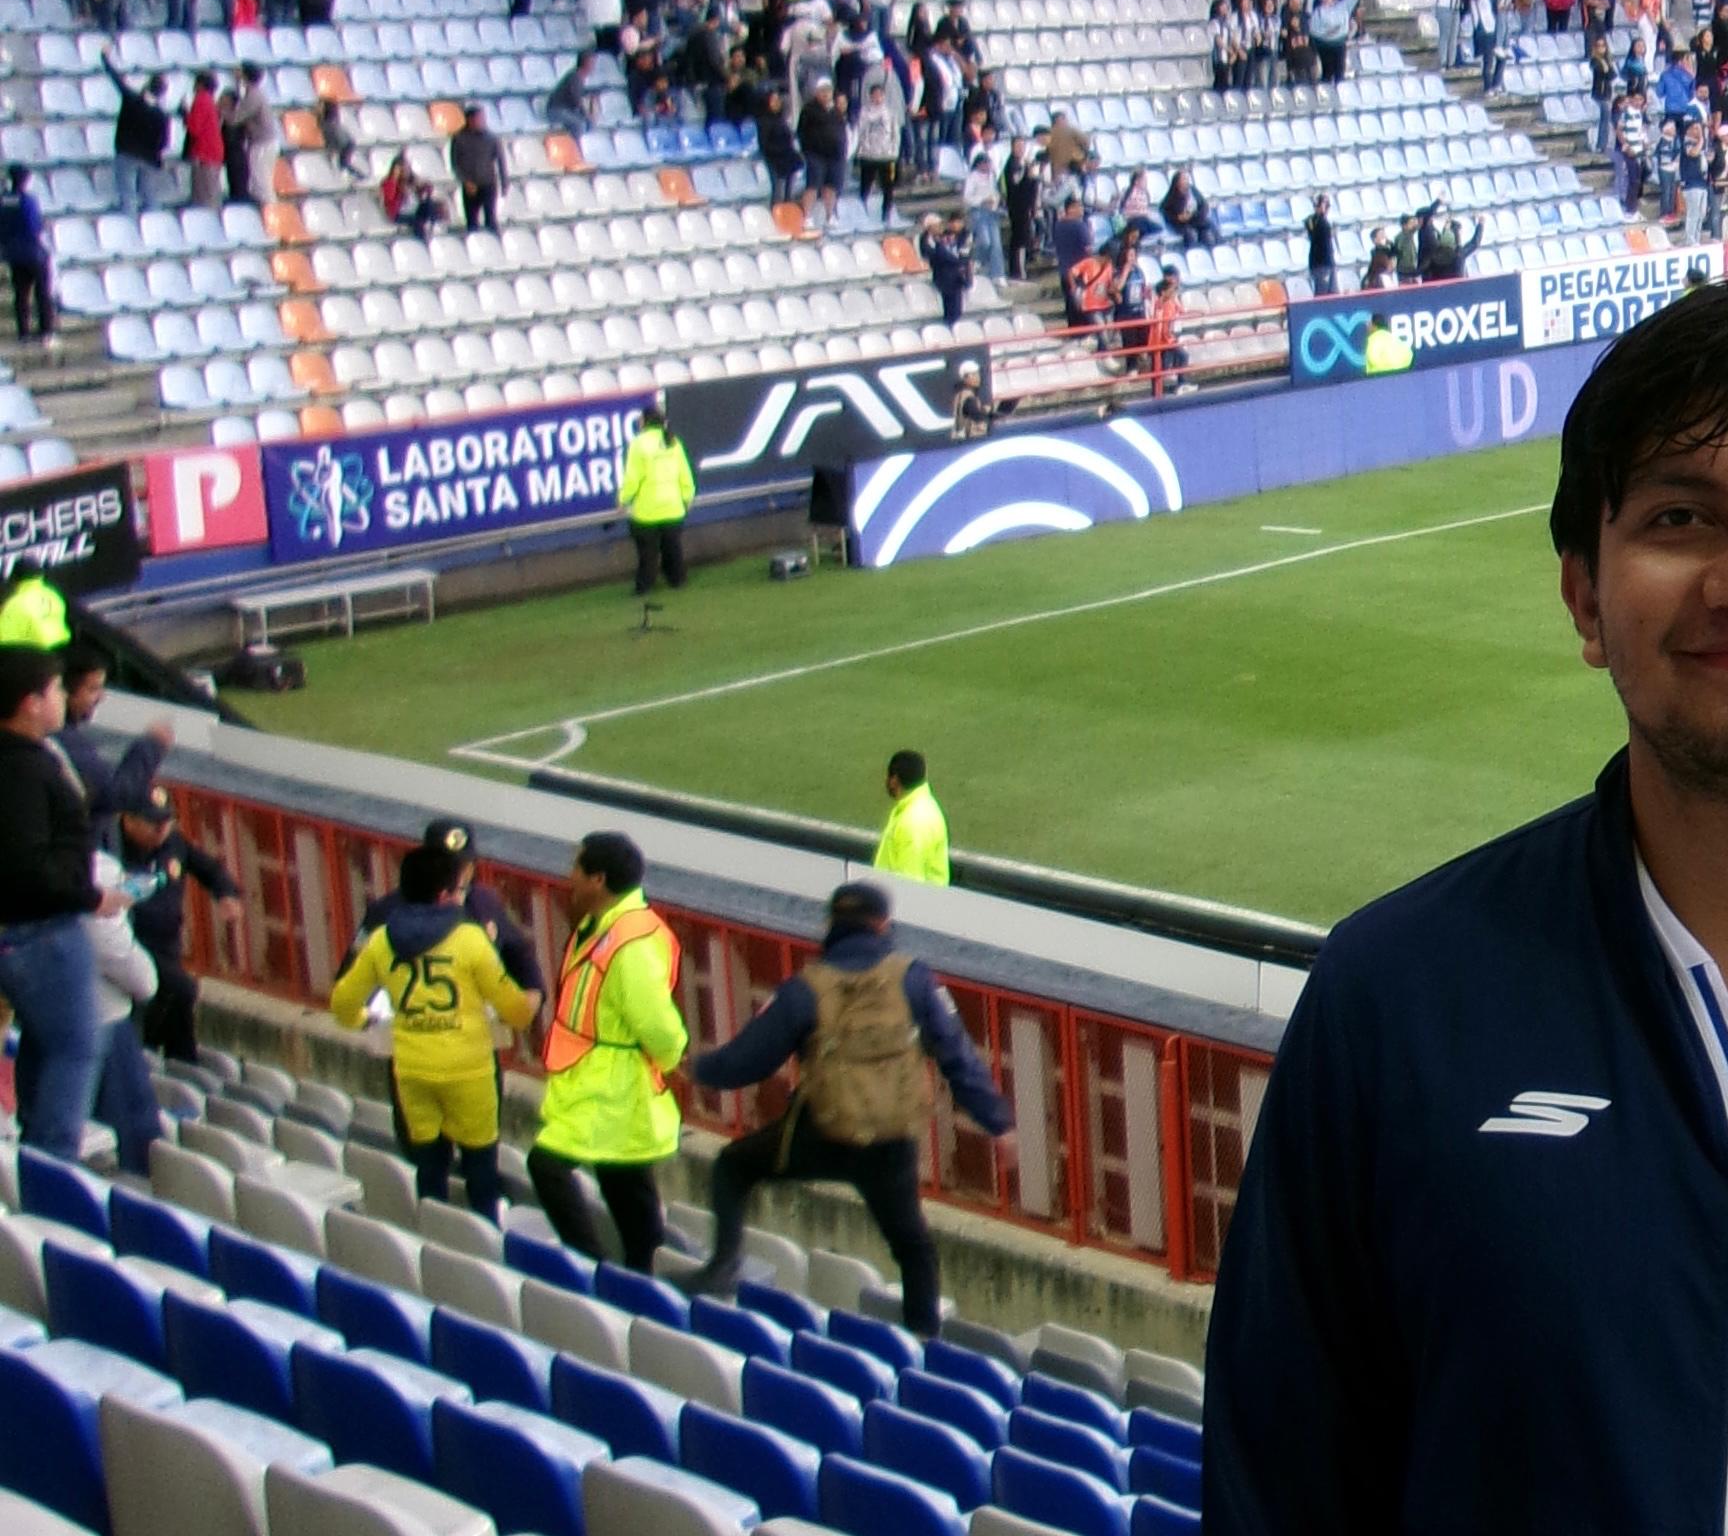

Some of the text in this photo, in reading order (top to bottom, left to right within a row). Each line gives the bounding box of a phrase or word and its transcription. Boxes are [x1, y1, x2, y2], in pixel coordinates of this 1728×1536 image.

[1390, 300, 1518, 350] BROXEL
[0, 487, 122, 551] CHERS
[174, 452, 242, 544] P
[384, 446, 626, 530] SANTA MARÍ
[390, 953, 458, 1015] 25
